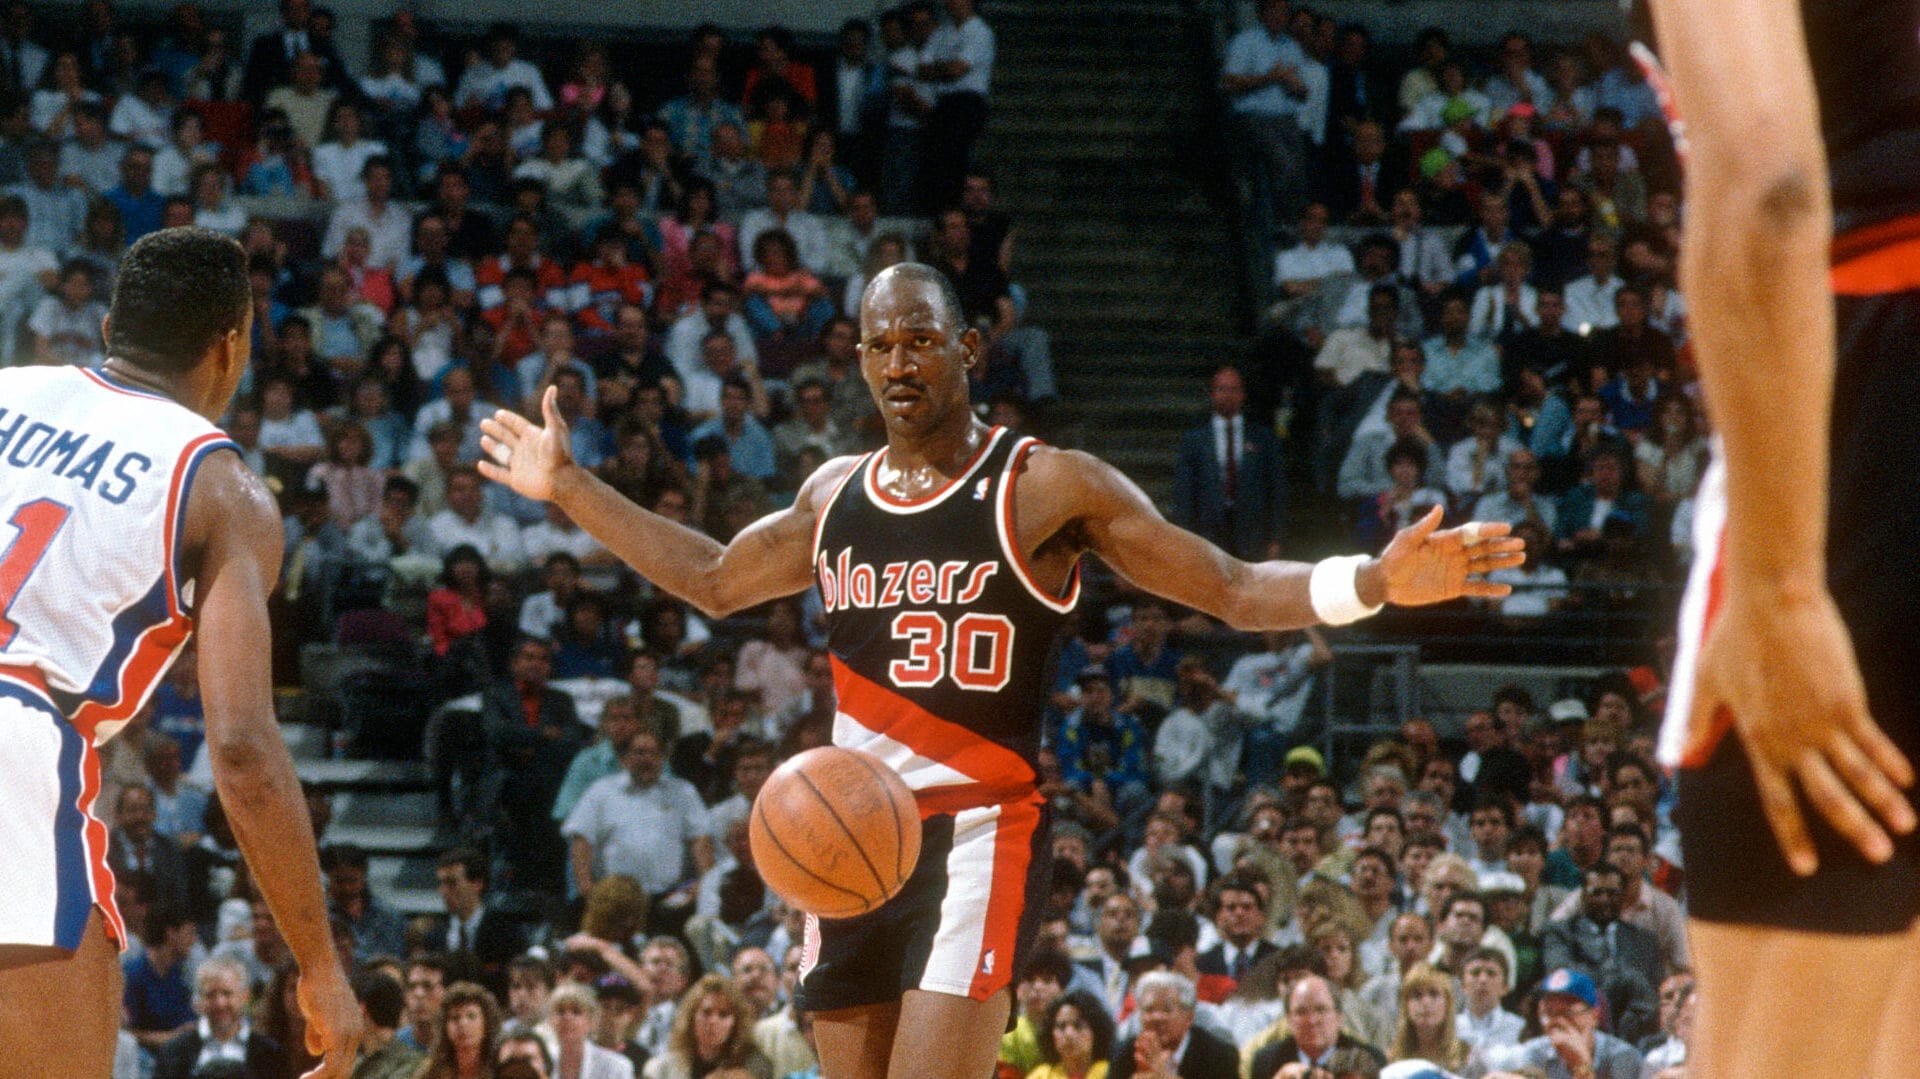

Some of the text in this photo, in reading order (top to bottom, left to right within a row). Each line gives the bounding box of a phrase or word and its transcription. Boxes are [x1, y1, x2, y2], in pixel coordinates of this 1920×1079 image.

[0, 407, 152, 504] HOMAS
[0, 497, 74, 653] 1
[818, 546, 998, 613] blazers
[888, 611, 1015, 692] 30
